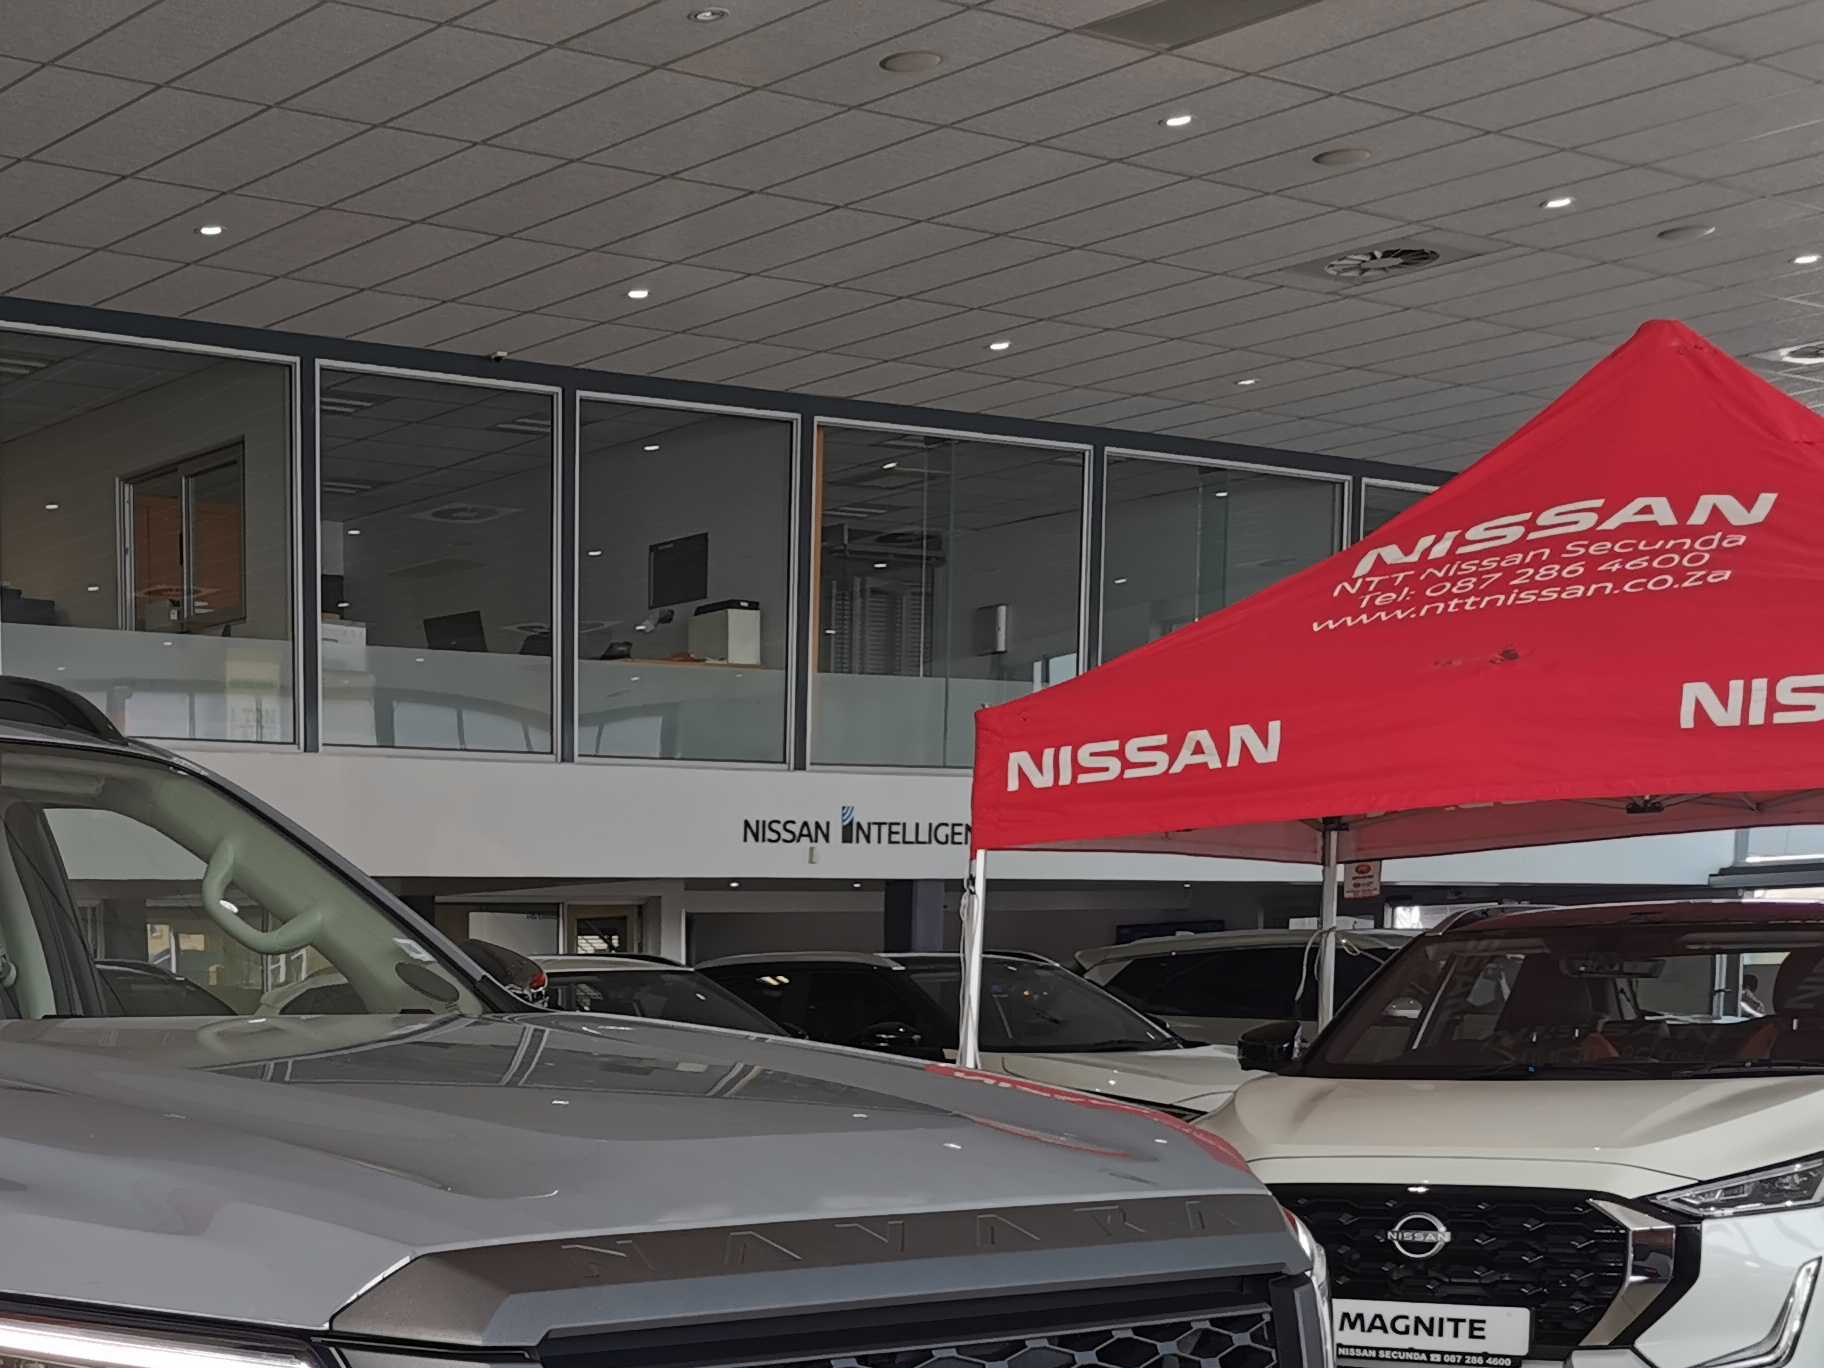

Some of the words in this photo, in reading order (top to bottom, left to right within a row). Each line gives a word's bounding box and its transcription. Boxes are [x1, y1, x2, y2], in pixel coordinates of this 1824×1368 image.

[1352, 493, 1778, 578] NISSAN
[1333, 571, 1410, 598] NTT
[1419, 547, 1551, 579] Nissan
[1560, 532, 1747, 559] Secunda
[1359, 588, 1415, 609] Tel:
[1424, 573, 1497, 599] 087
[1508, 561, 1585, 586] 286
[1596, 551, 1711, 573] 4600
[1312, 569, 1732, 632] www.nttnissan.co.za
[1007, 720, 1281, 792] NISSAN
[743, 819, 830, 844] NISSAN
[1387, 1231, 1451, 1242] NISSAN
[1339, 1312, 1487, 1340] MAGNITE
[1338, 1347, 1376, 1358] NISSAN
[1378, 1350, 1427, 1361] SECUNDA
[1486, 1357, 1512, 1366] 4600
